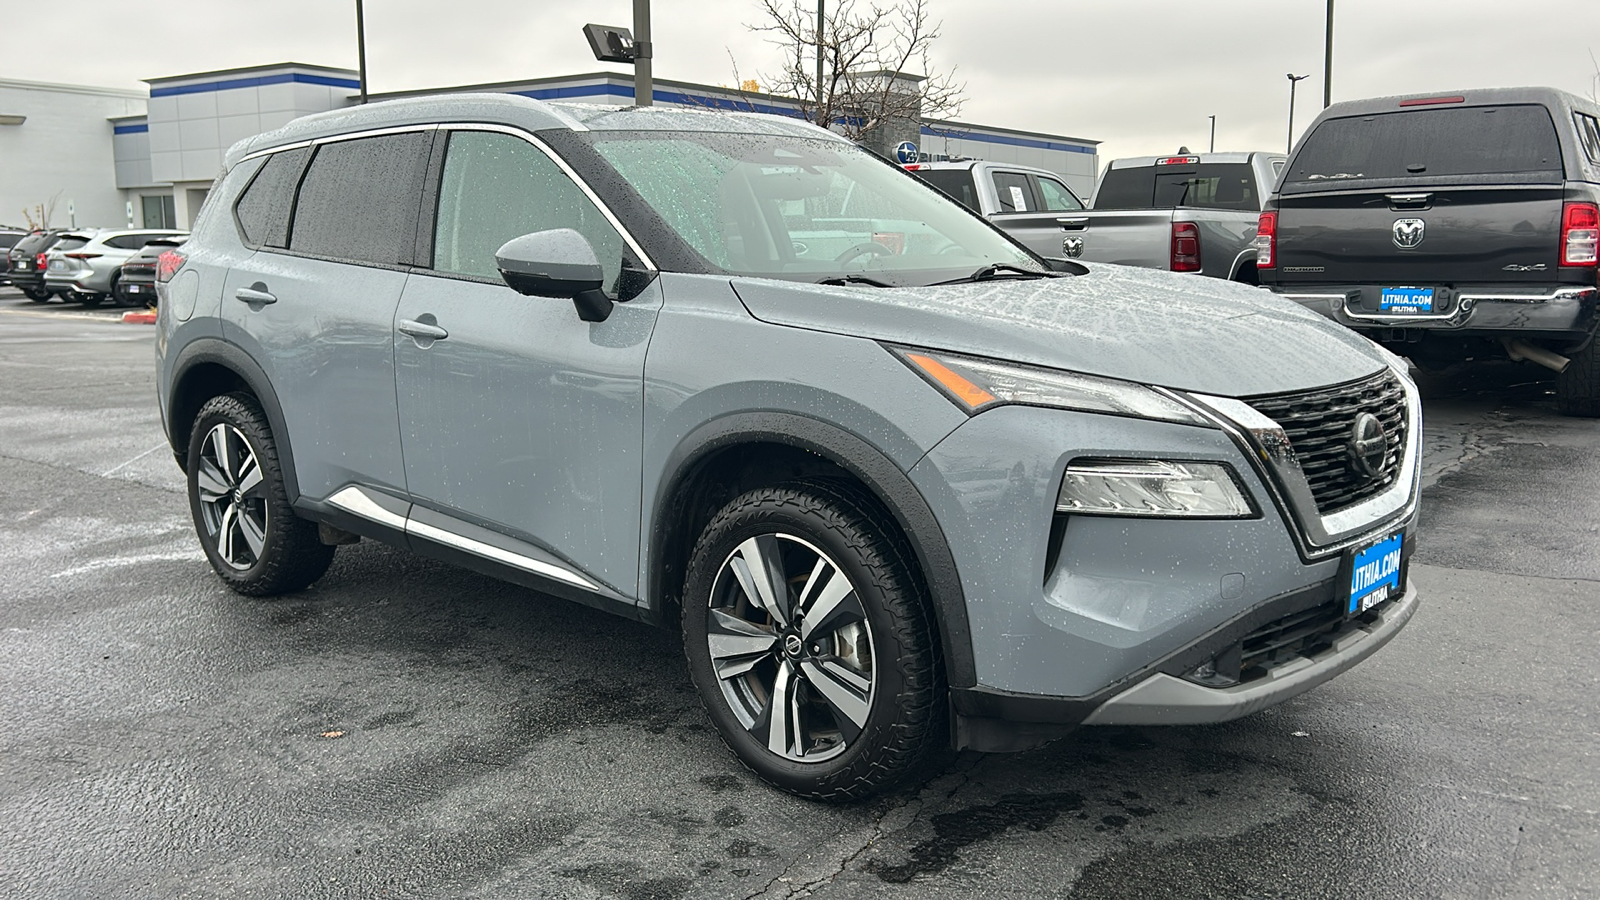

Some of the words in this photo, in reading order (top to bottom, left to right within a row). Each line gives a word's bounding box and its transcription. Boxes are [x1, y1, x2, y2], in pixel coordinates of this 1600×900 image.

[1381, 293, 1433, 306] LITHIA.COM
[1397, 305, 1418, 313] LITHIA
[1351, 548, 1402, 595] LITHIA.COM
[1367, 585, 1388, 608] LITHIA
